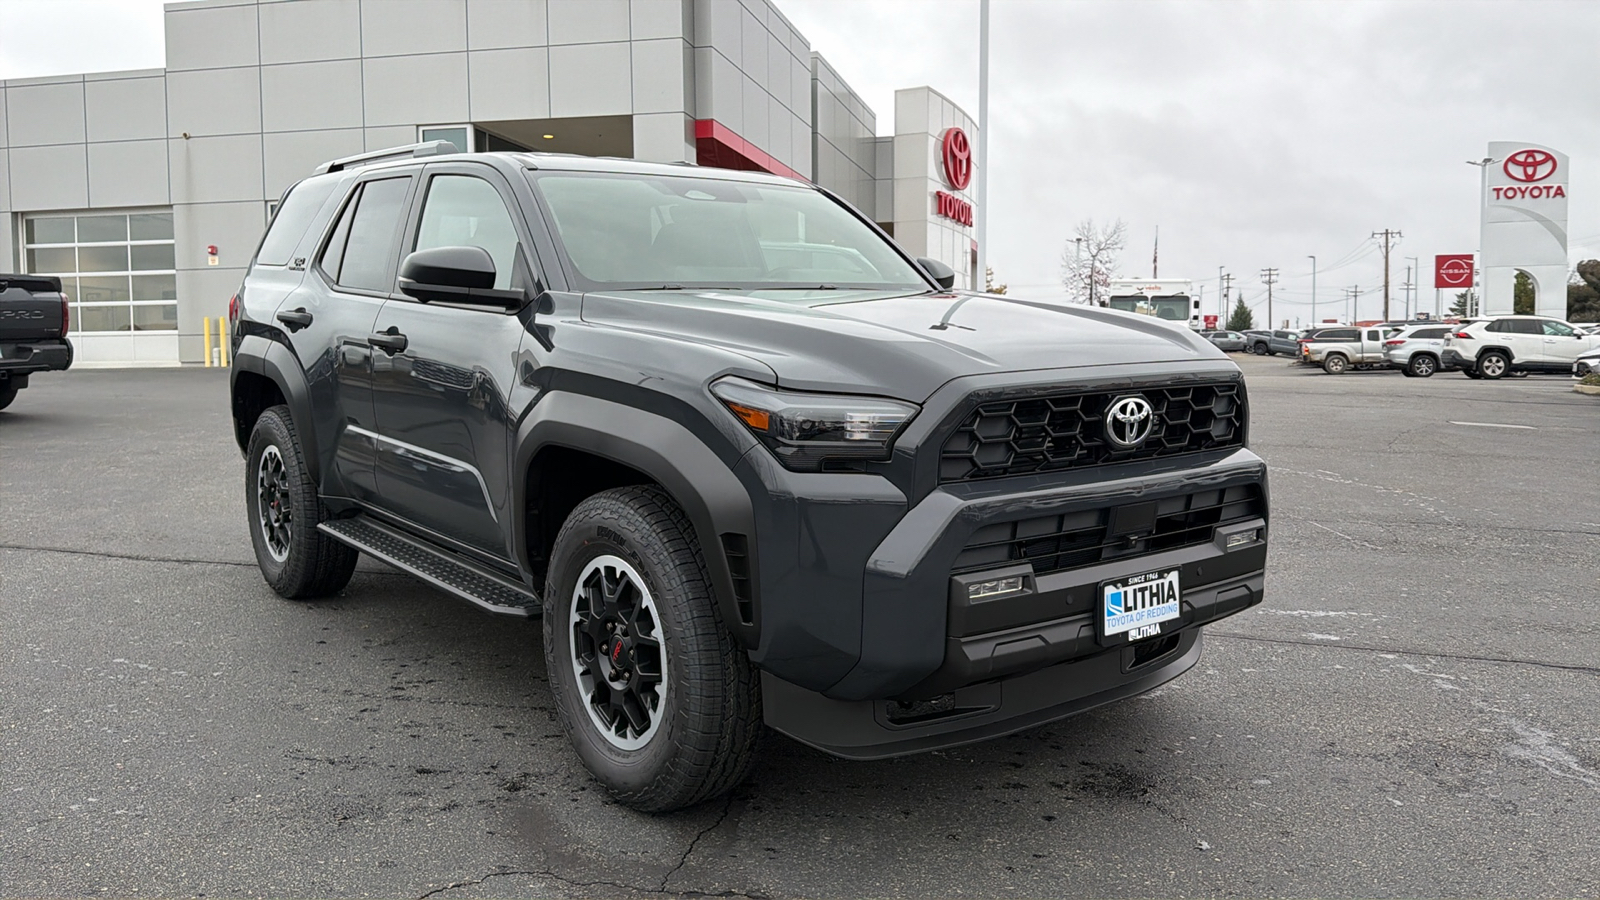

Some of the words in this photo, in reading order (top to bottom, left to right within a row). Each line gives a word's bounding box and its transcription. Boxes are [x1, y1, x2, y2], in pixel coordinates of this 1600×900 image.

[1492, 185, 1566, 200] TOYOTA
[936, 191, 973, 228] TOYOTA
[0, 310, 45, 319] PRO
[1128, 574, 1145, 585] SINCE
[1146, 572, 1159, 581] 1946
[1123, 580, 1177, 613] LITHIA
[1106, 613, 1135, 628] TOYOTA
[1135, 611, 1146, 622] OF
[1146, 603, 1178, 619] REDDING
[1136, 622, 1162, 640] LITHIA
[612, 640, 623, 662] TRD
